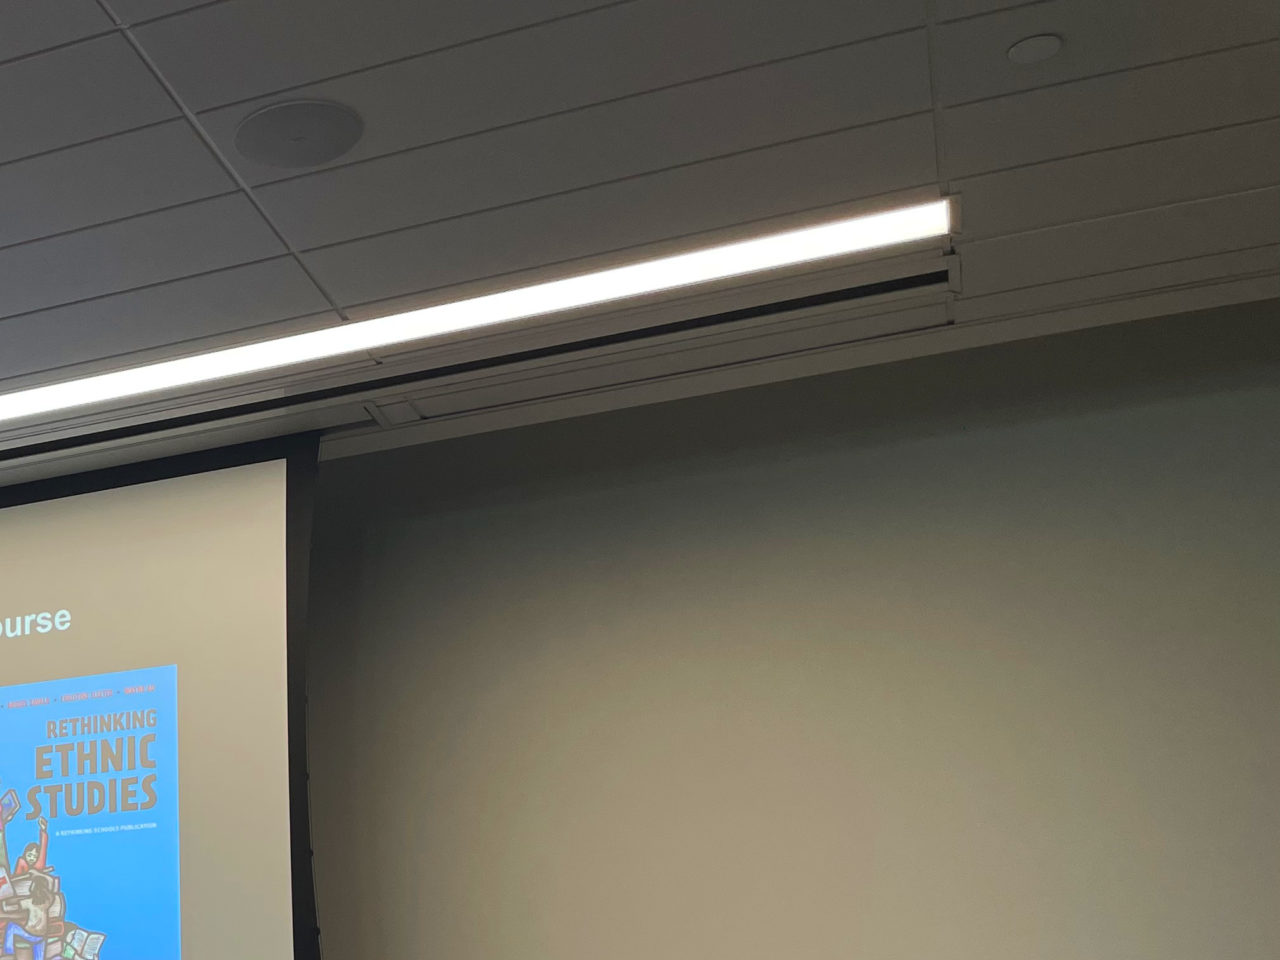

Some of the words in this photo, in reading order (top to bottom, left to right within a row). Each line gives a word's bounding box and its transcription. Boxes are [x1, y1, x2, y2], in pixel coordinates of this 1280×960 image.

[47, 709, 157, 738] RETHINKING
[35, 733, 157, 780] ETHNIC
[25, 773, 158, 821] STUDIES
